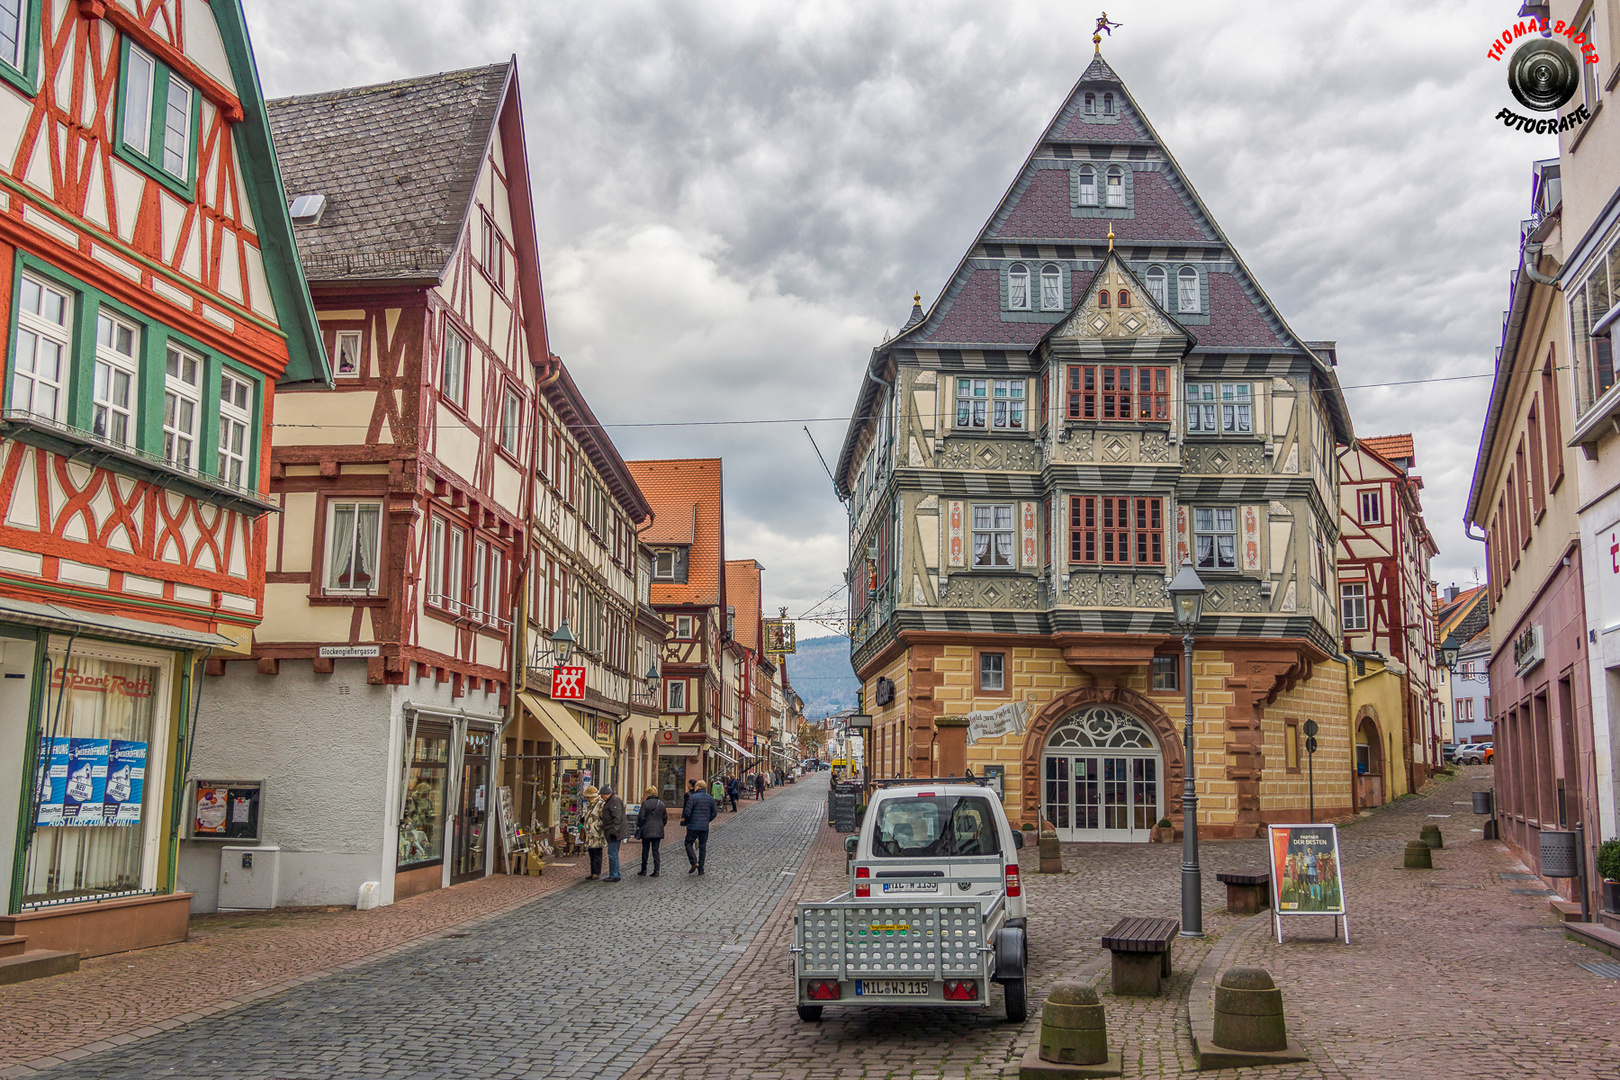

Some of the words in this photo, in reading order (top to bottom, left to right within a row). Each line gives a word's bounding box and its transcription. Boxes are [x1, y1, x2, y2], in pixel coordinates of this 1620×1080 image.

[51, 668, 110, 692] Sport
[109, 675, 151, 697] Roth
[49, 816, 66, 827] AUS
[64, 816, 88, 827] LIEBE
[89, 816, 107, 827] ZUM
[107, 817, 134, 827] SPORT!
[863, 982, 883, 993] MIL
[891, 982, 905, 993] WJ
[908, 982, 928, 993] 115
